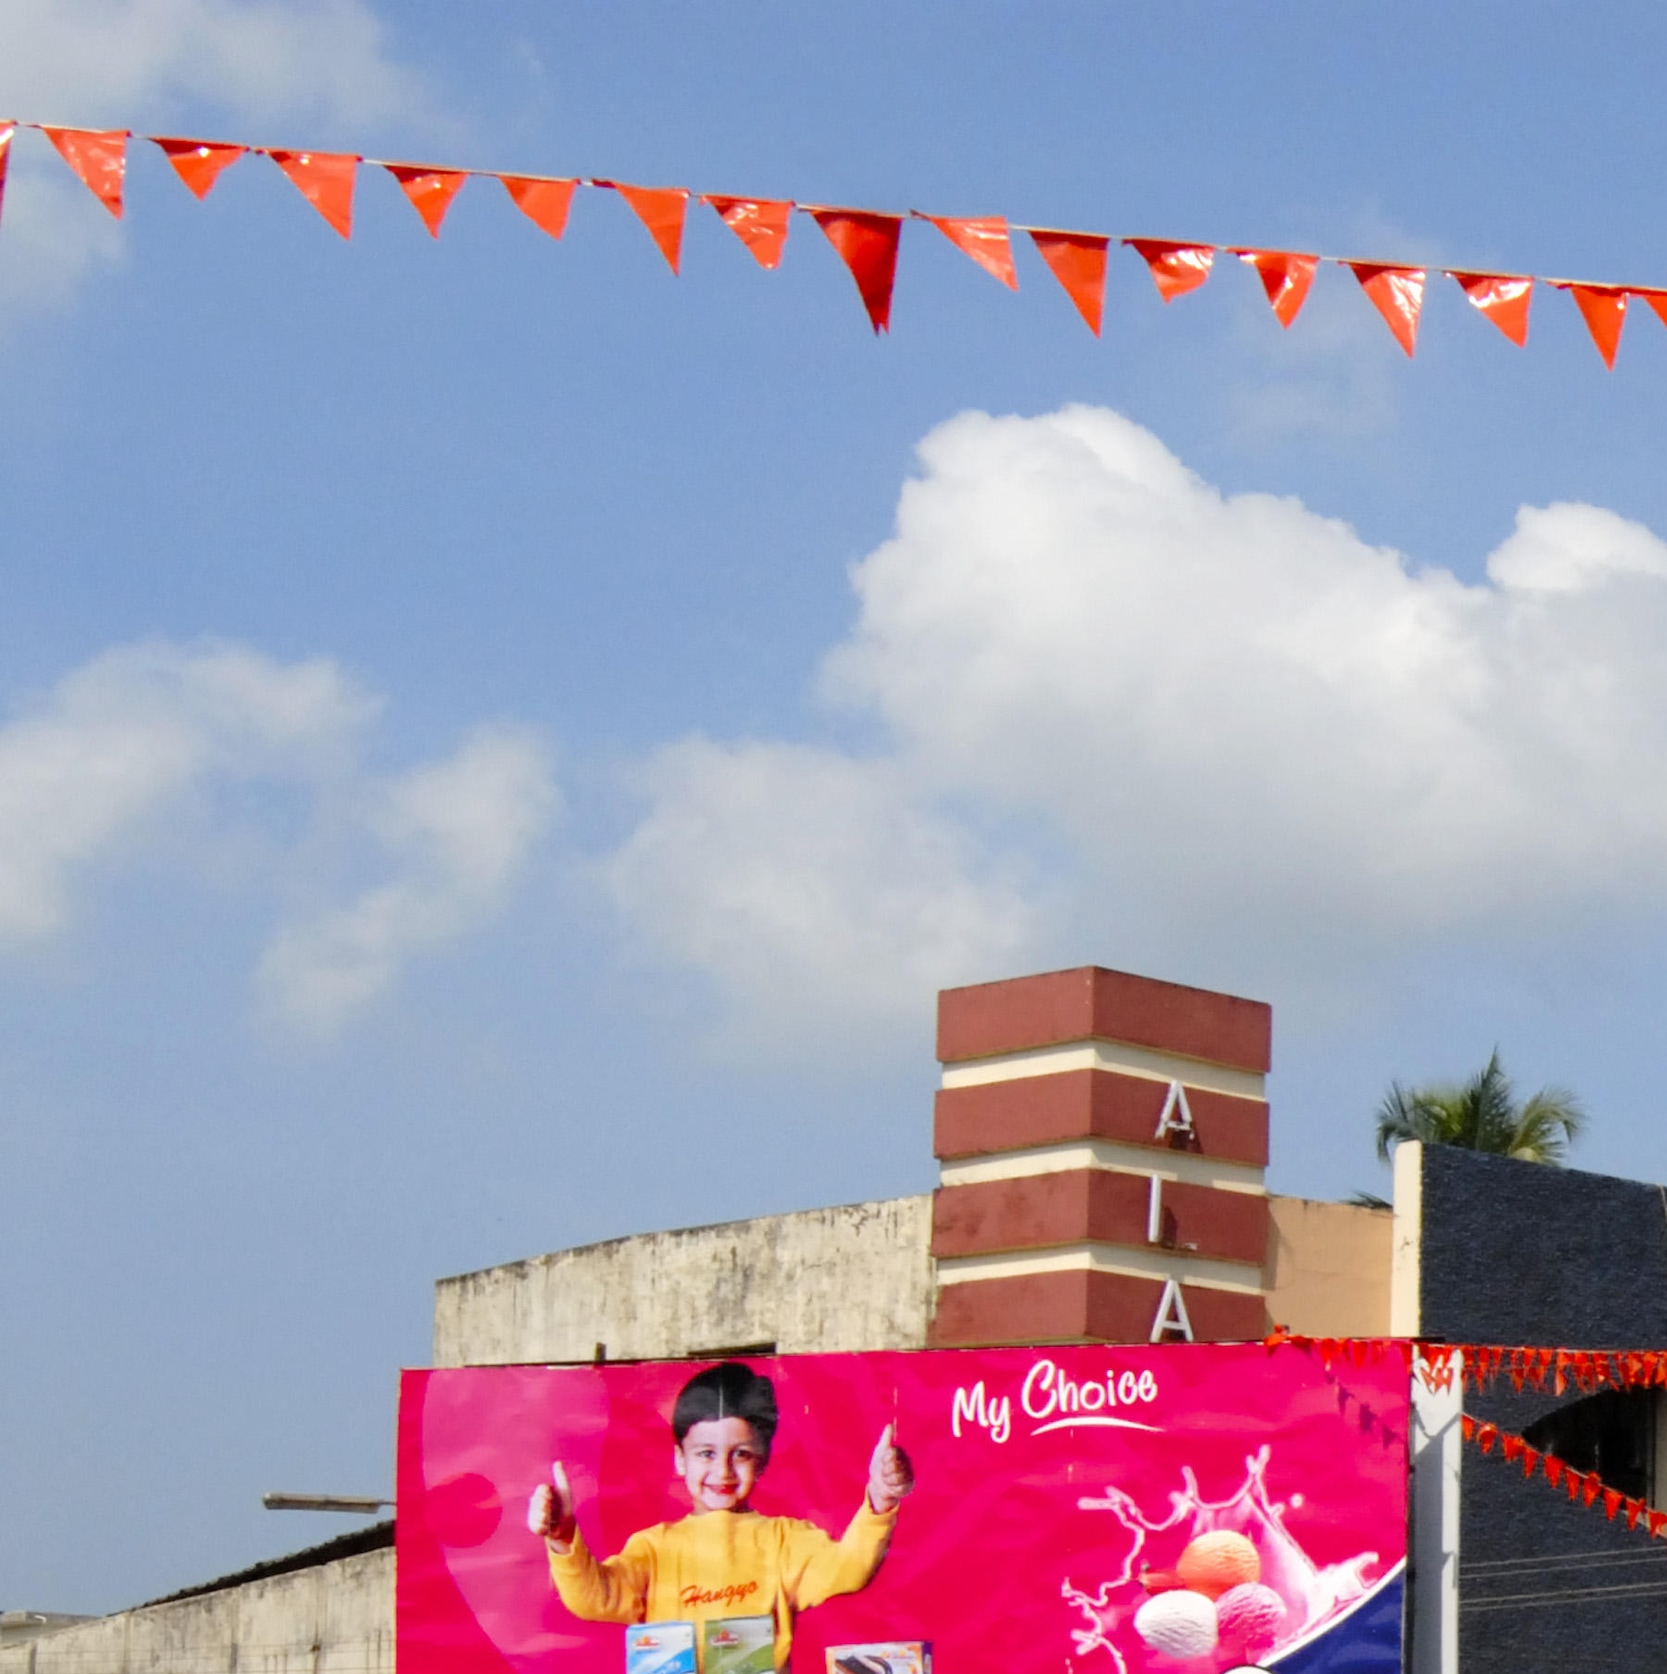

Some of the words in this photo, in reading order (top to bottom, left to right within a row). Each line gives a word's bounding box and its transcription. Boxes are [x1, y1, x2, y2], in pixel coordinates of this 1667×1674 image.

[952, 1380, 1011, 1444] My
[1021, 1359, 1158, 1419] Choice
[679, 1580, 760, 1609] Hangyo
